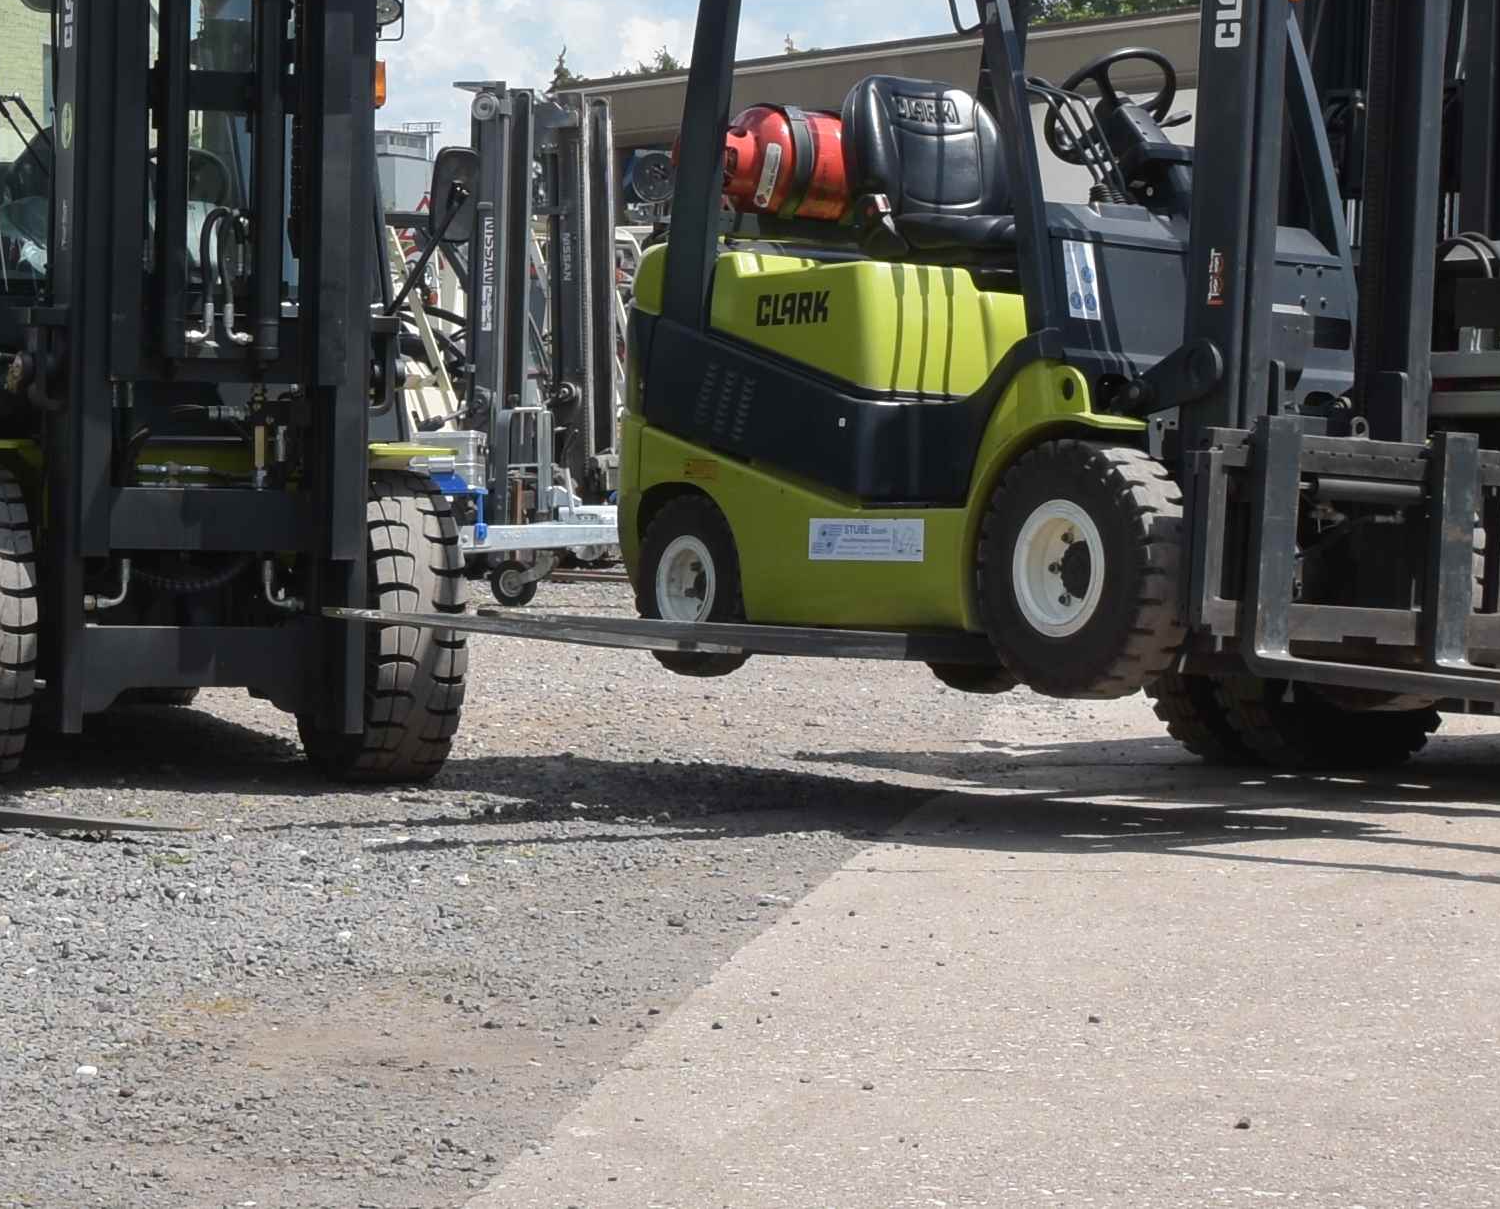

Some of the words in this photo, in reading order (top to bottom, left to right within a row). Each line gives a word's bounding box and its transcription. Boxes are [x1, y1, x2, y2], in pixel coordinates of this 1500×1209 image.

[483, 217, 495, 284] NISSAN
[562, 231, 572, 282] NISSAN
[756, 290, 830, 326] CLARK
